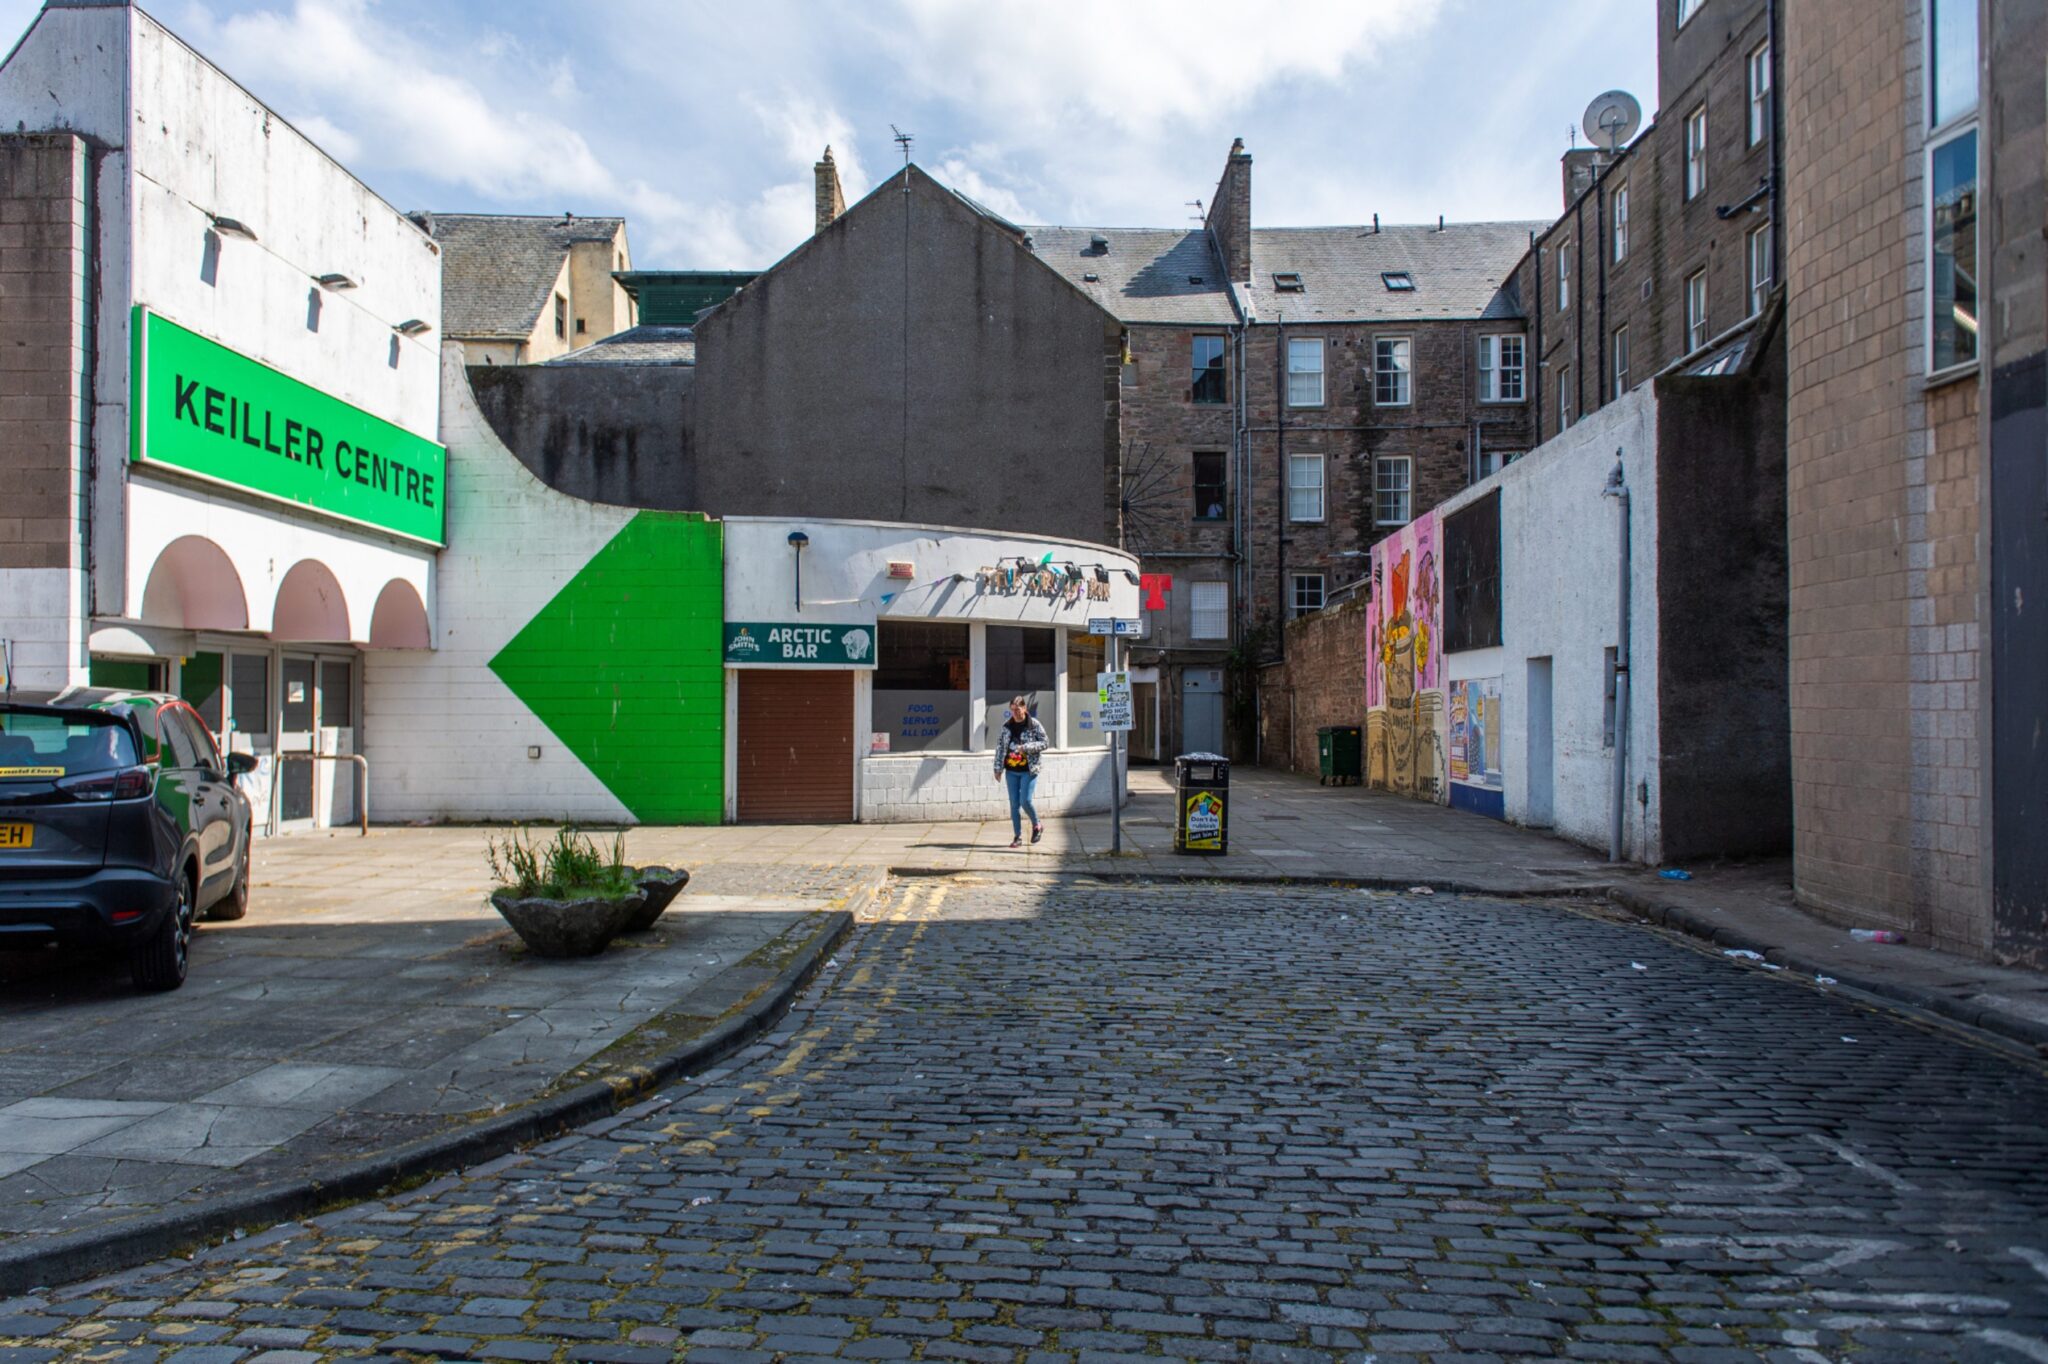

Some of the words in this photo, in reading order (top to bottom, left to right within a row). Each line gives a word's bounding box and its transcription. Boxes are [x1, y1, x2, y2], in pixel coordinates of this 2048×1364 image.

[175, 373, 324, 470] KEILLER
[335, 440, 434, 508] CENTRE
[733, 635, 755, 643] JOHN
[768, 628, 832, 644] ARCTIC
[728, 641, 760, 652] SMITH'S
[782, 644, 818, 658] BAR
[908, 704, 934, 712] FOOD
[902, 716, 939, 725] SERVED
[902, 728, 919, 737] ALL
[921, 728, 940, 737] DAY
